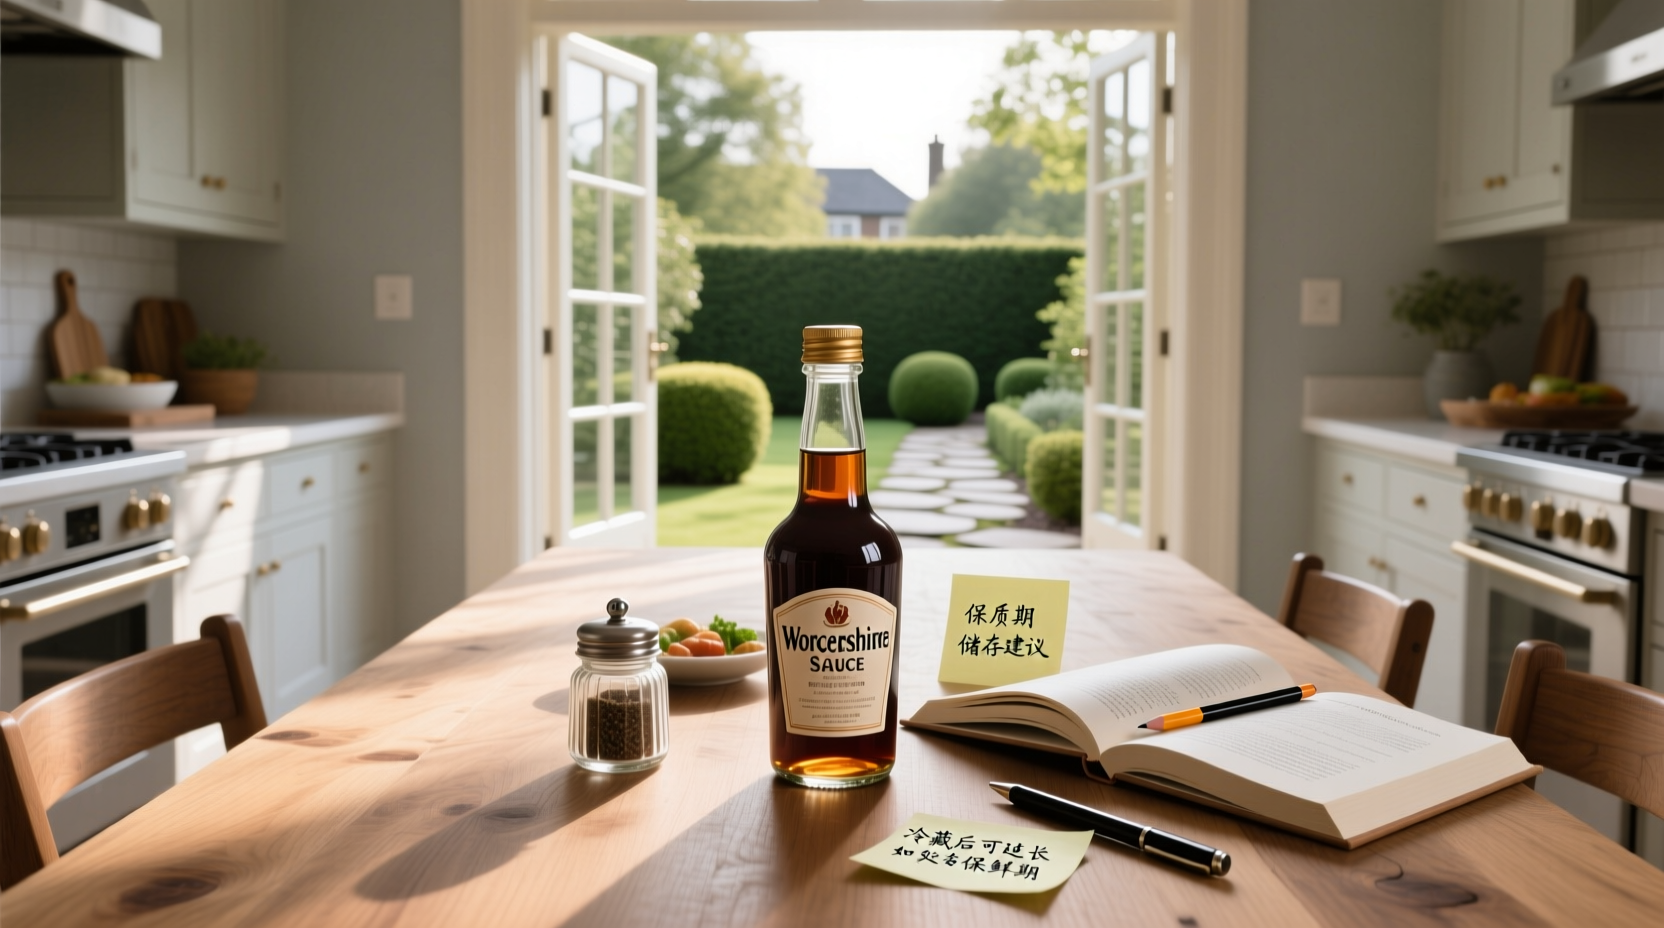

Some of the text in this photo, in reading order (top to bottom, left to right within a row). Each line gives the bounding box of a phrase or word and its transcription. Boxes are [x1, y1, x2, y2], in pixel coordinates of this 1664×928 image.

[964, 603, 1035, 629] 保质期
[957, 633, 1050, 658] 储存建议
[809, 655, 865, 672] SAUCE
